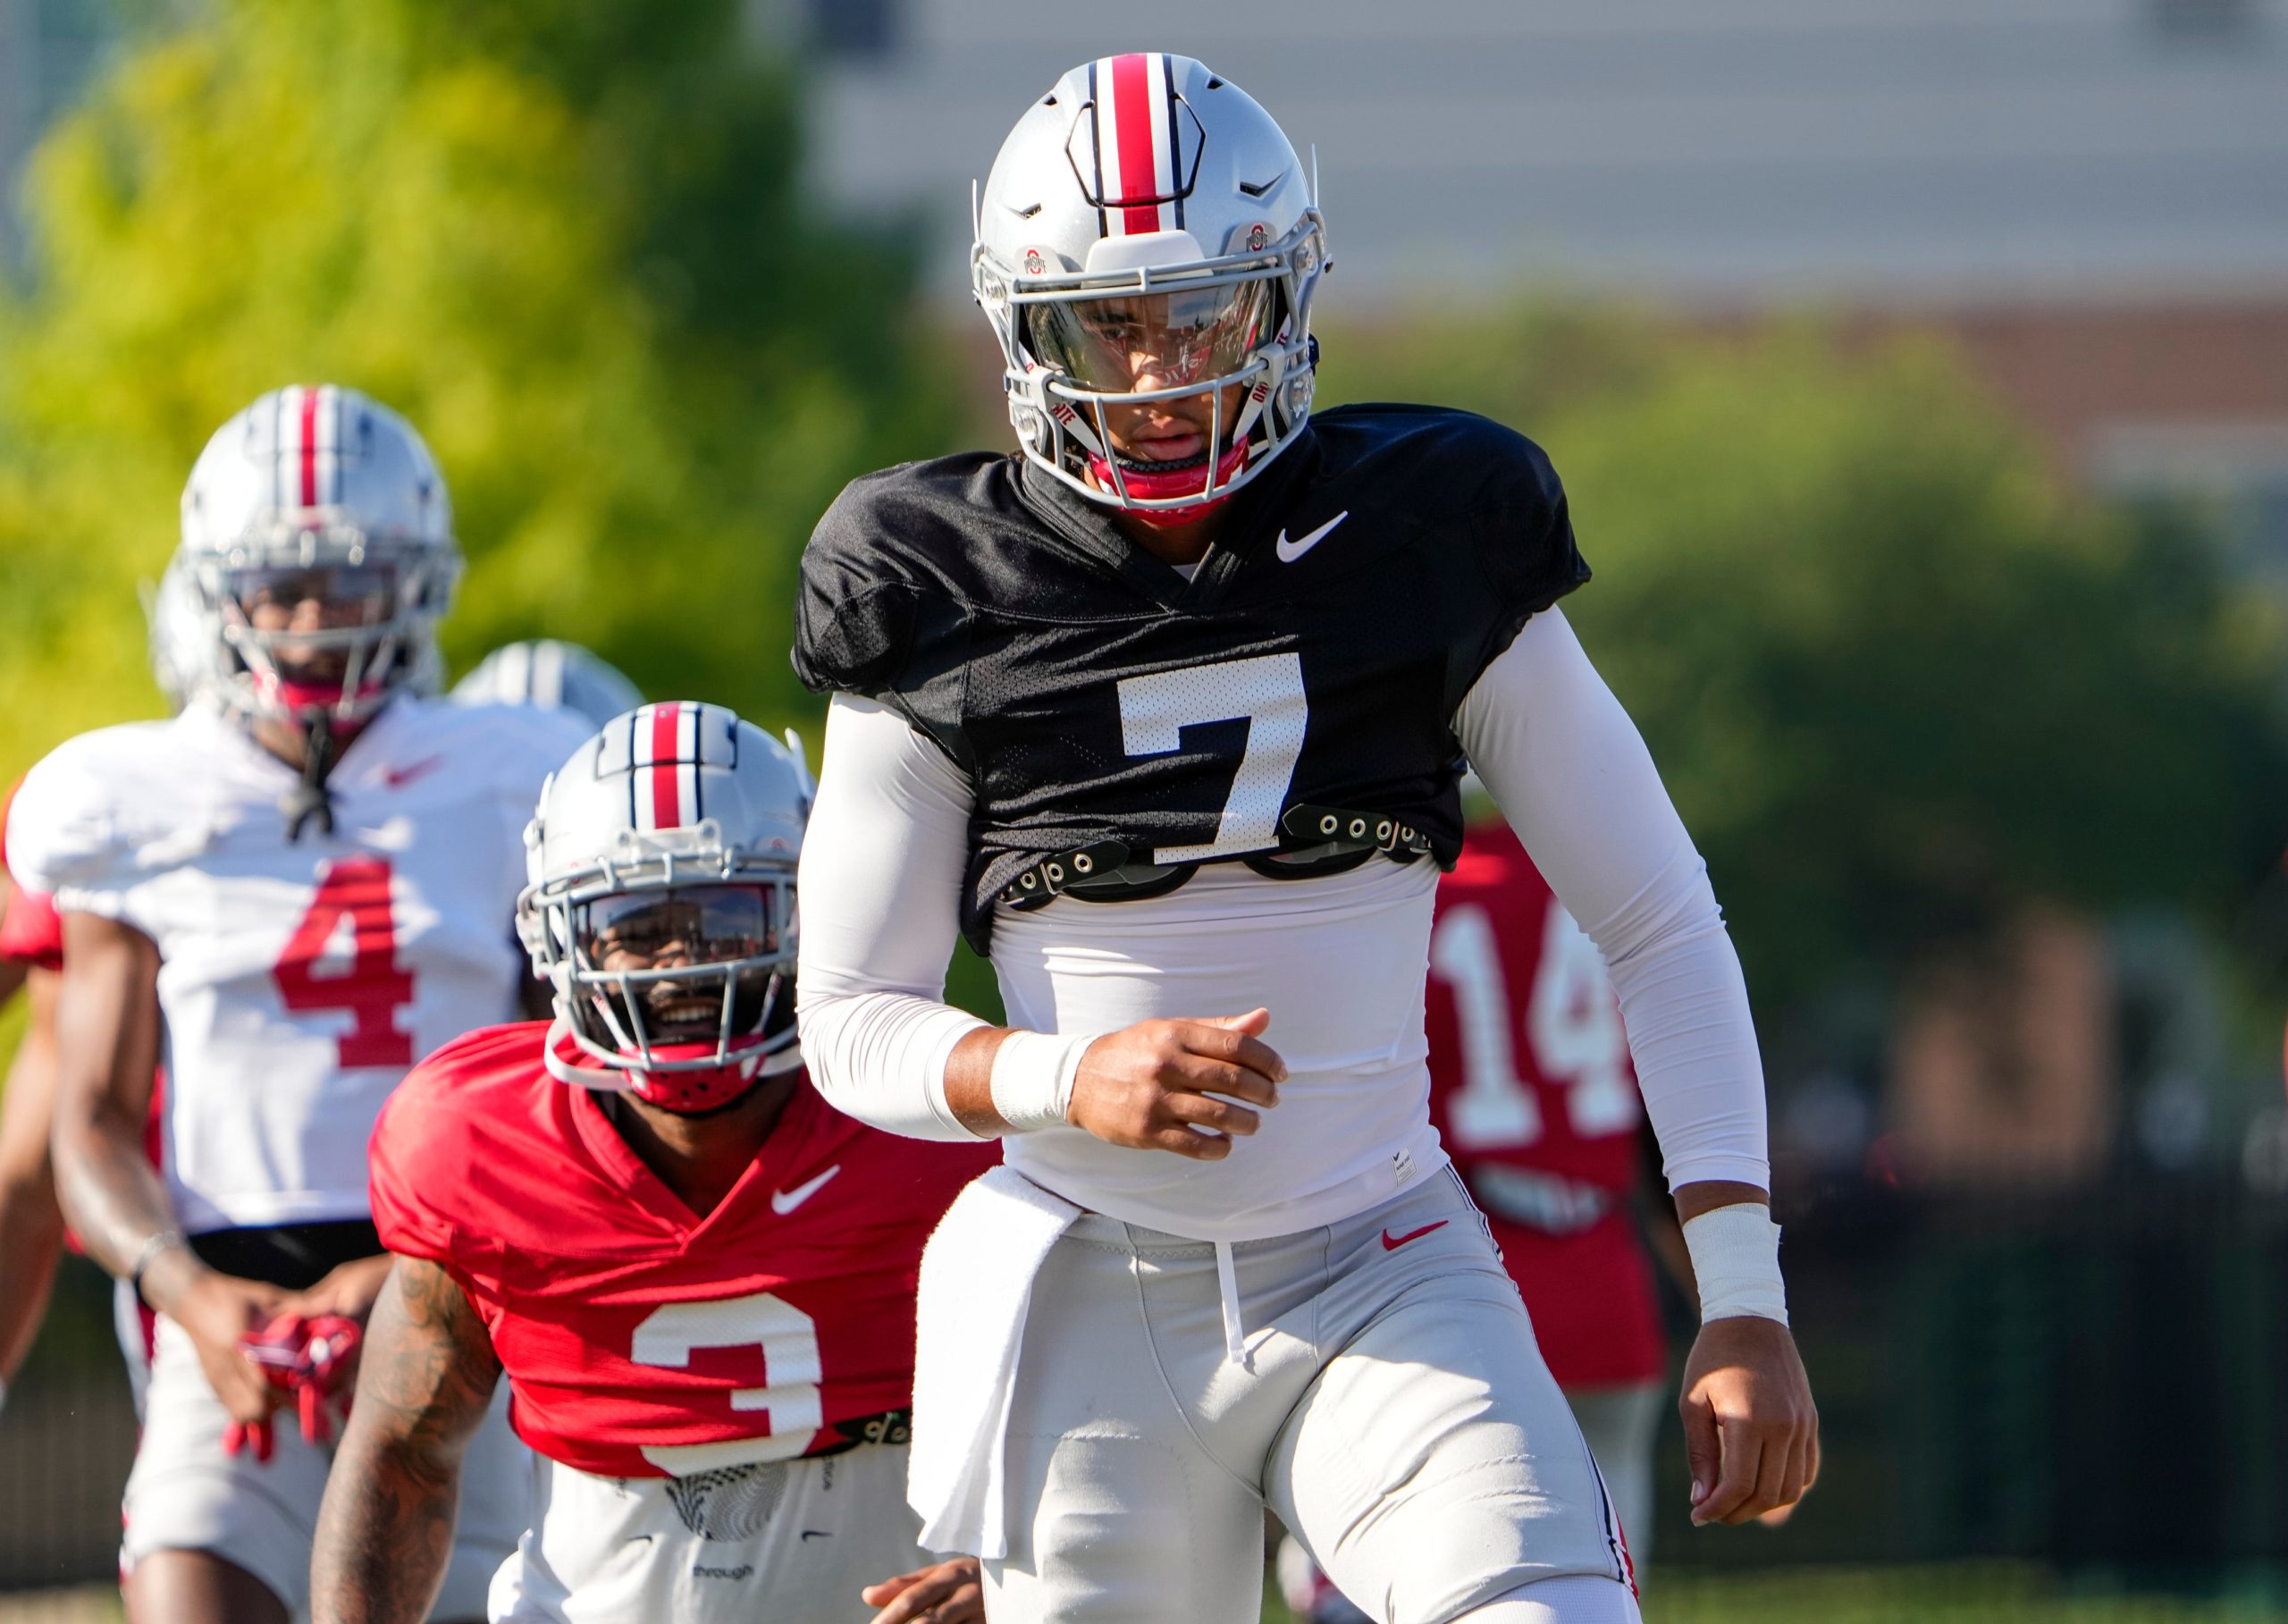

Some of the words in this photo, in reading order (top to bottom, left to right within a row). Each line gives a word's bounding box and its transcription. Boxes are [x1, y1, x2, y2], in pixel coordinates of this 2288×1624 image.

[1117, 652, 1308, 864] 7
[273, 854, 417, 1068] 4
[1432, 896, 1639, 1149] 14
[630, 1292, 823, 1477] 3
[694, 1564, 754, 1583] through
